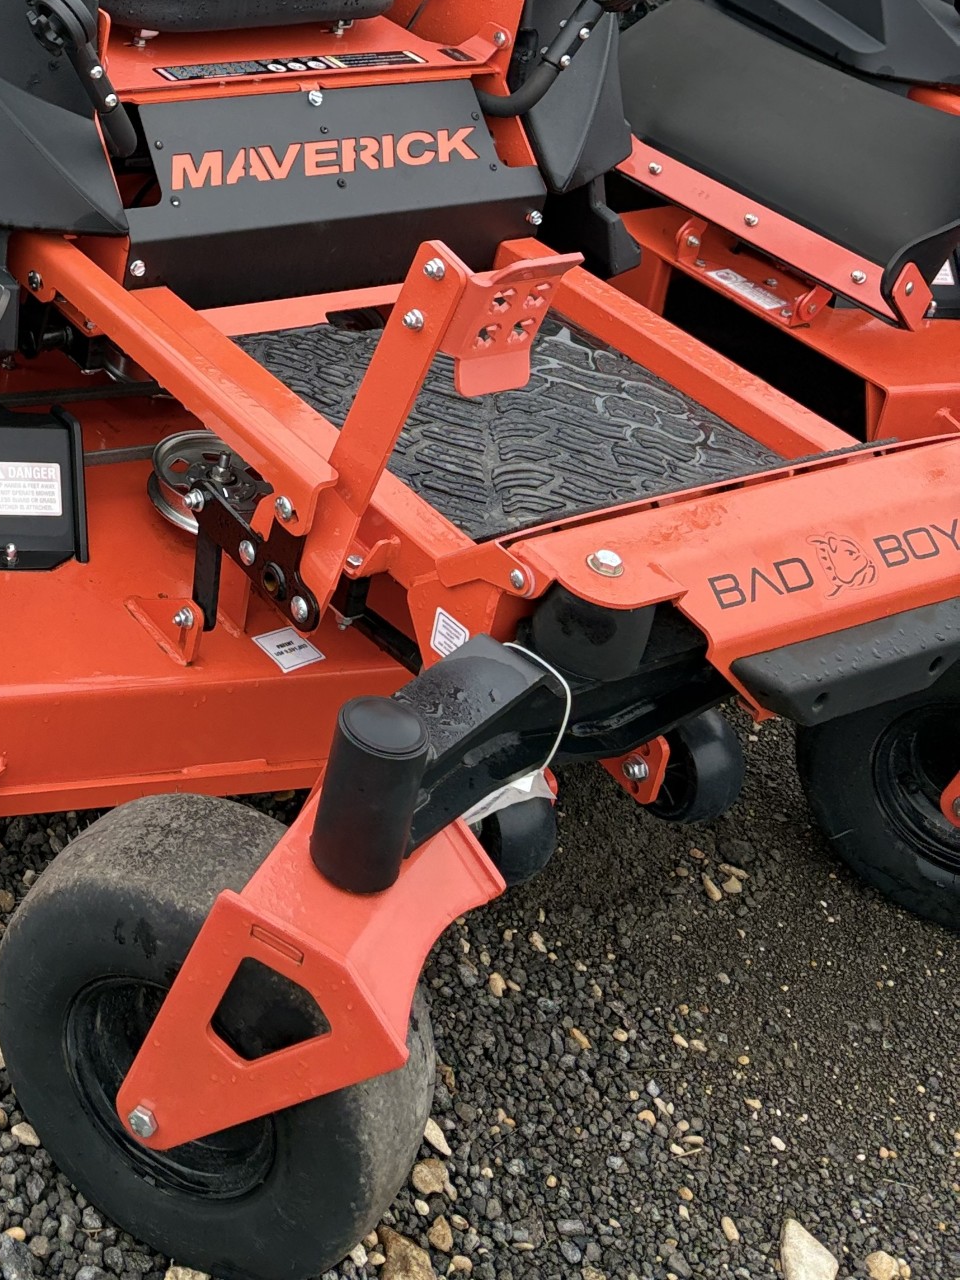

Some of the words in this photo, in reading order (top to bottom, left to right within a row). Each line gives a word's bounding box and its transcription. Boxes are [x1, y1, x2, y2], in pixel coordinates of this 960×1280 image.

[171, 126, 480, 191] MAVERICK
[8, 466, 57, 480] DANGER
[707, 557, 815, 610] BAD
[872, 518, 960, 568] BOY
